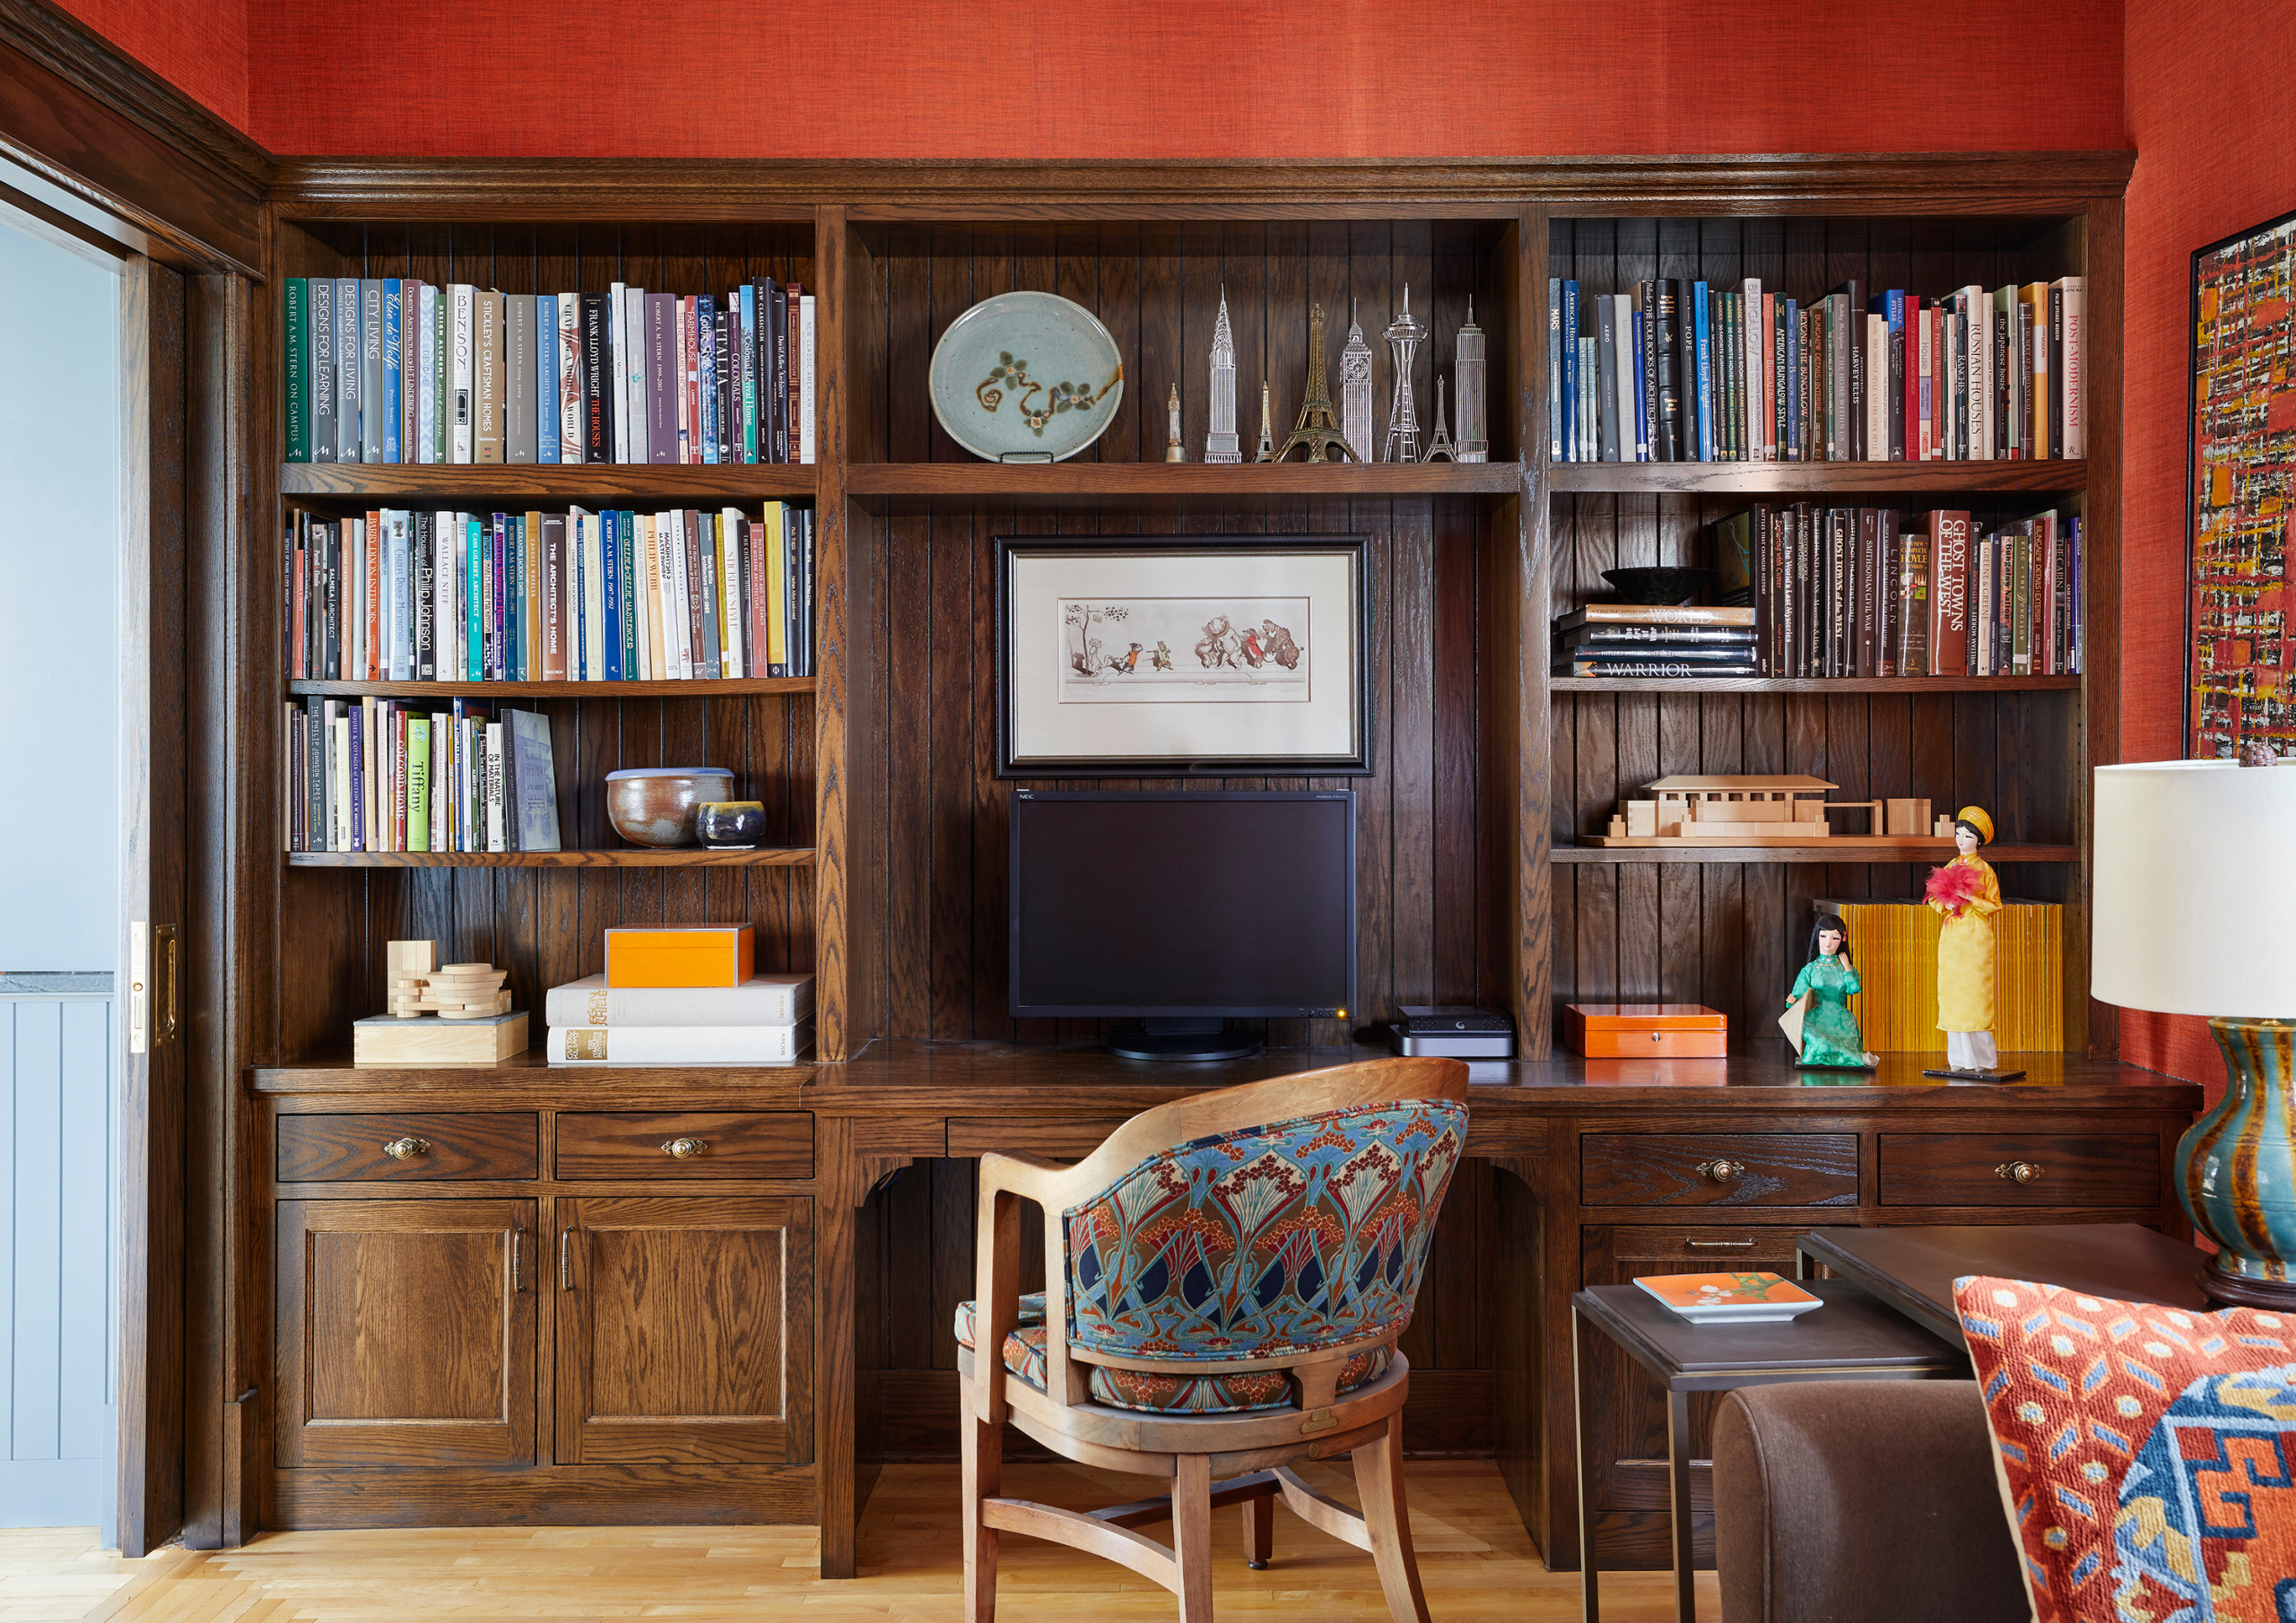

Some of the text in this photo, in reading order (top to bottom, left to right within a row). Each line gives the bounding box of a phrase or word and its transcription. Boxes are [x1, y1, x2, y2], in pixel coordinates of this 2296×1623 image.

[289, 286, 297, 323] ROBERT
[368, 290, 379, 360] CITY LIVING
[383, 293, 401, 369] Elsie de Wolfe
[457, 295, 467, 369] BENSON
[1551, 308, 1560, 330] MARS
[1747, 283, 1759, 355] BUNGALOW
[290, 348, 298, 378] STERN
[318, 285, 330, 415] DESIGNS FOR LEARNING
[345, 284, 356, 400] DESIGNS FOR LIVING
[483, 300, 492, 431] STICKLEY'S CRAFTSMAN HOMES
[1700, 339, 1709, 408] Frank Lloyd Wright
[1800, 347, 1808, 365] THE
[1921, 342, 1929, 369] House
[2068, 315, 2079, 427] POST-MODERNISM
[291, 384, 299, 399] ON
[589, 309, 601, 447] FRANK LLOYD WRIGHT THE HOUSES
[731, 352, 741, 402] COLONIALS
[744, 335, 754, 426] Colonial Revival House
[1776, 328, 1787, 428] AMERICAN BUNGALOW STYLE
[1800, 367, 1808, 418] BUNGALOW
[1957, 355, 1966, 395] RANCHES
[1970, 324, 1982, 435] RUSSIAN HOUSES
[291, 403, 299, 442] CAMPUS
[369, 518, 378, 624] BARRY DIXON INTERIORS
[420, 531, 428, 557] Houses
[421, 559, 428, 568] of
[648, 530, 657, 591] PHILIP WEBB
[1900, 555, 1927, 563] HOYLE
[1939, 520, 1952, 618] OF THE WEST
[1951, 520, 1966, 631] GHOST TOWNS
[395, 549, 405, 641] CHARLES RENNIE MACKINTOSH
[418, 568, 432, 599] Philip
[1865, 540, 1873, 631] SMITHSONIAN CIVIL WAR
[1890, 549, 1898, 624] LINCOLN
[2004, 543, 2013, 620] Bungalow Nation
[421, 600, 433, 651] Johnson
[1648, 608, 1713, 624] WORLD
[1784, 606, 1793, 643] Mysteries
[1606, 663, 1692, 677] WARRIOR
[396, 740, 404, 821] COLCORD HOME
[409, 760, 424, 812] Tiffany
[488, 753, 494, 763] OF
